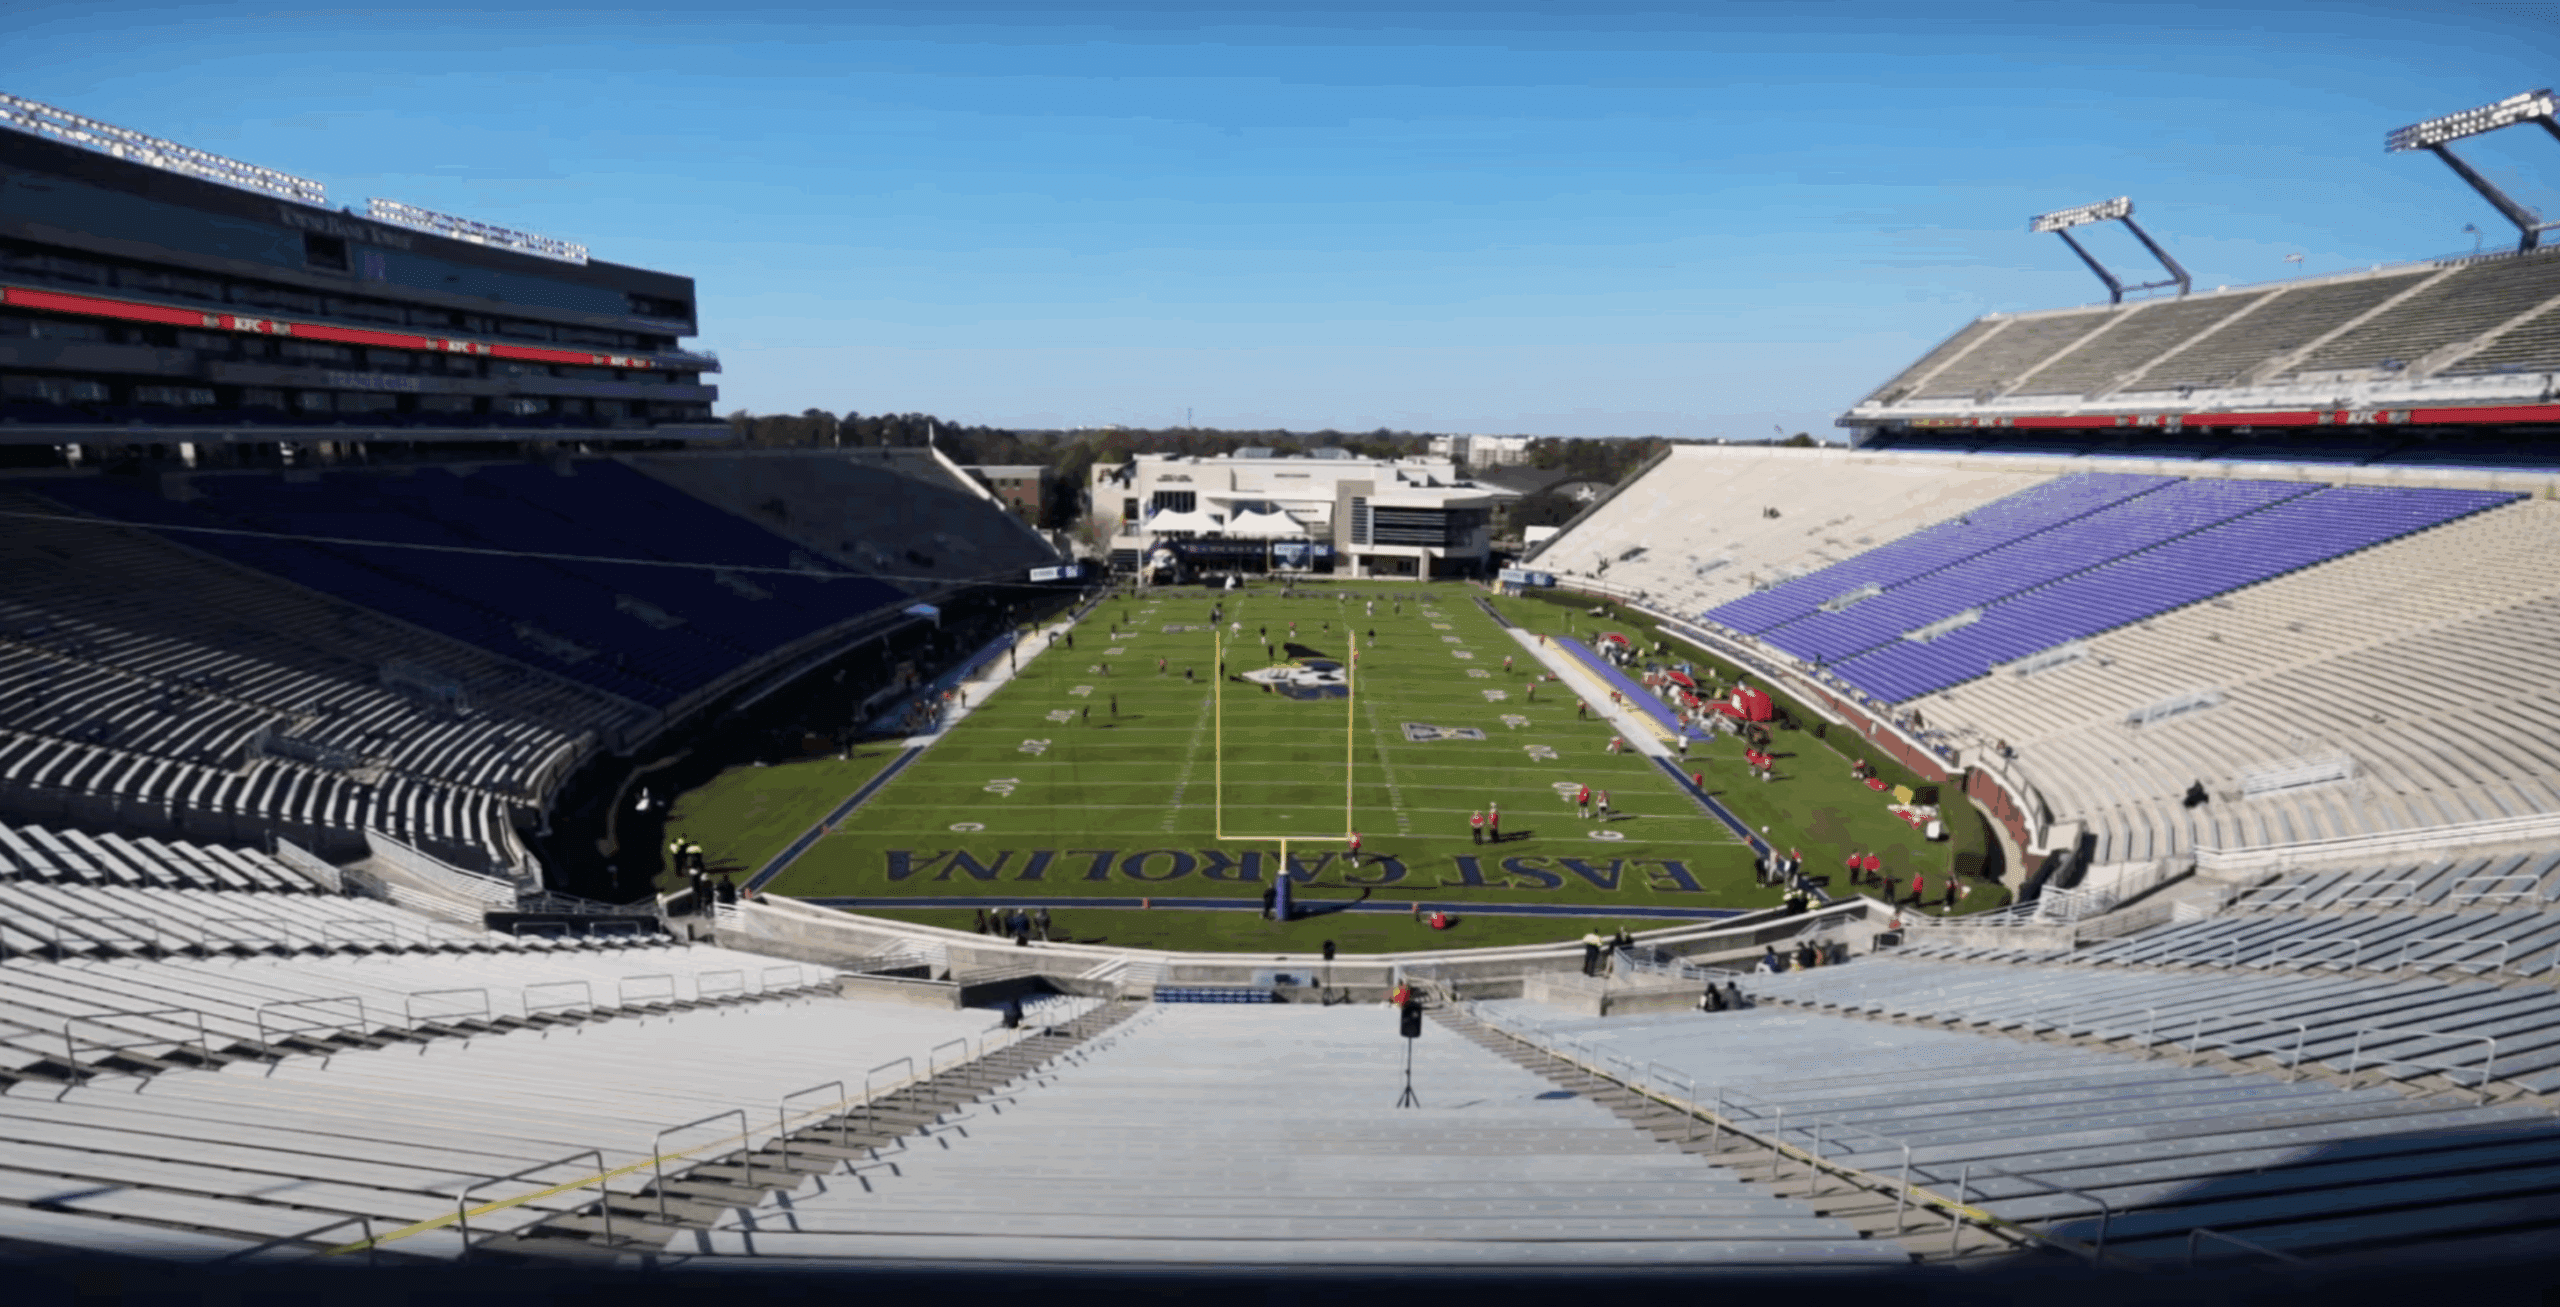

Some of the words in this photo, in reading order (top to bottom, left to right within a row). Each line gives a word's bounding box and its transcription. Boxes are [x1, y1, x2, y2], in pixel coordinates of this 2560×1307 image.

[234, 316, 263, 334] KFC
[448, 341, 469, 353] KFC
[2347, 410, 2378, 425] KFC
[885, 849, 1409, 887] CAROLINA
[1437, 855, 1706, 892] EAST
